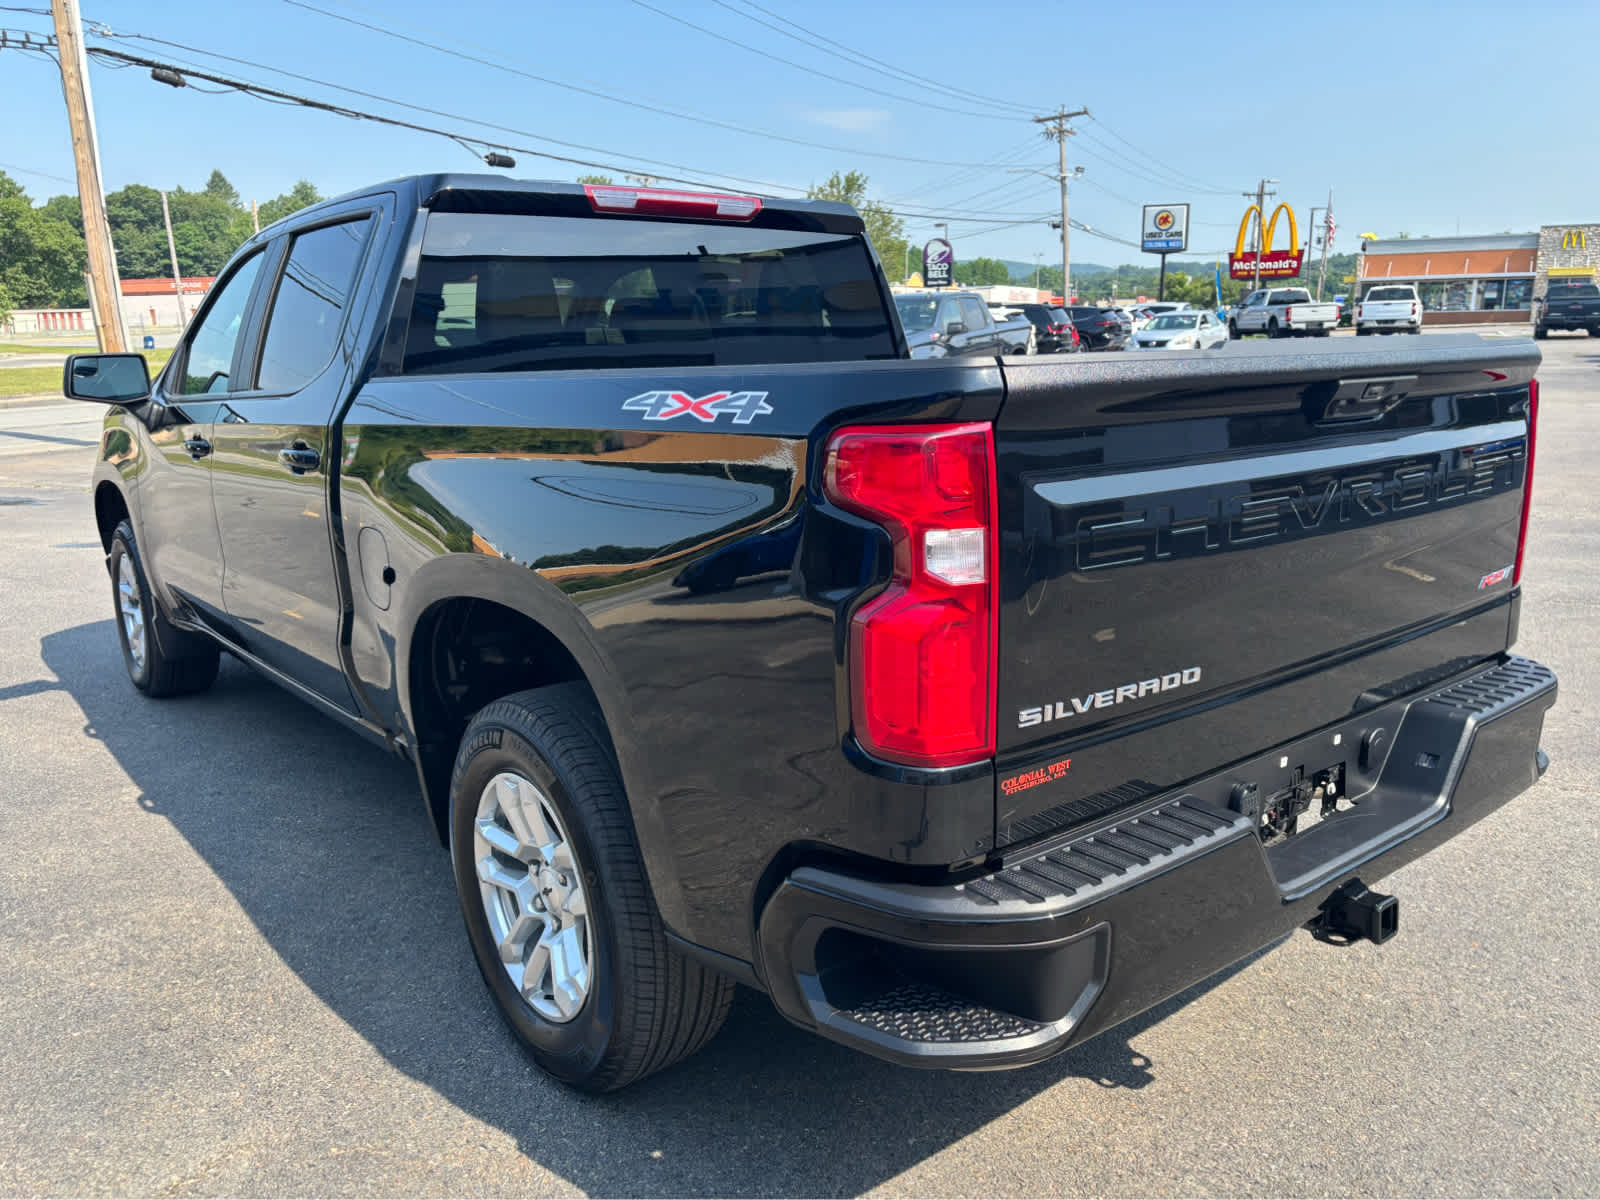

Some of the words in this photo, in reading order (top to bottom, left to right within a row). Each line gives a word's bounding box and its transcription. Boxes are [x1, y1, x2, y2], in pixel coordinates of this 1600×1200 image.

[1165, 230, 1183, 238] CARS
[926, 263, 949, 271] TACO
[1232, 260, 1298, 270] McDonald's
[927, 270, 949, 278] BELL
[1076, 447, 1525, 571] CHEVROLET
[1018, 666, 1202, 729] SILVERADO
[1001, 768, 1046, 791] COLONIAL
[1047, 758, 1072, 775] WEST
